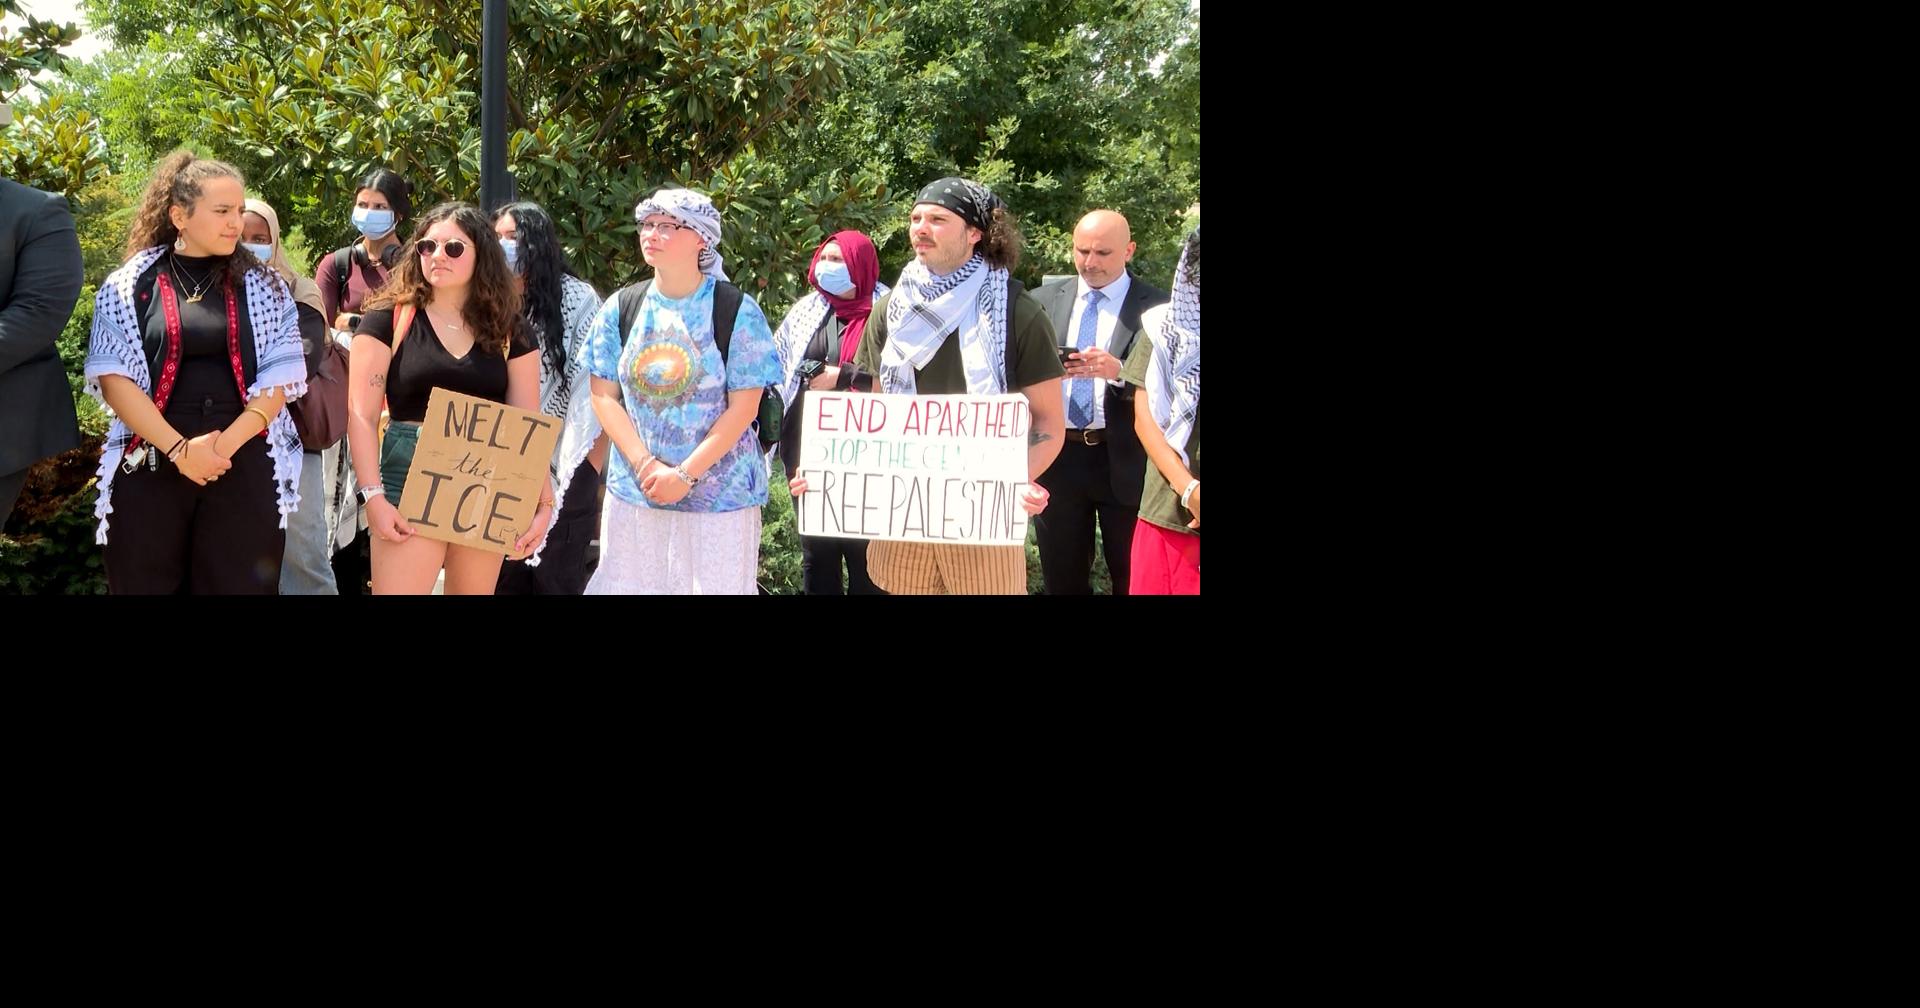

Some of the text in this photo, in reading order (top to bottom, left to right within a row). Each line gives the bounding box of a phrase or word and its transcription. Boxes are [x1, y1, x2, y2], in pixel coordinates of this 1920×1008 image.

[444, 400, 551, 456] MELT
[818, 397, 1028, 438] END APARTHEID
[449, 452, 505, 480] the
[809, 438, 868, 467] STOP
[872, 440, 917, 469] THE
[407, 470, 522, 545] ICE
[802, 470, 1027, 540] FREE PALESTINE
